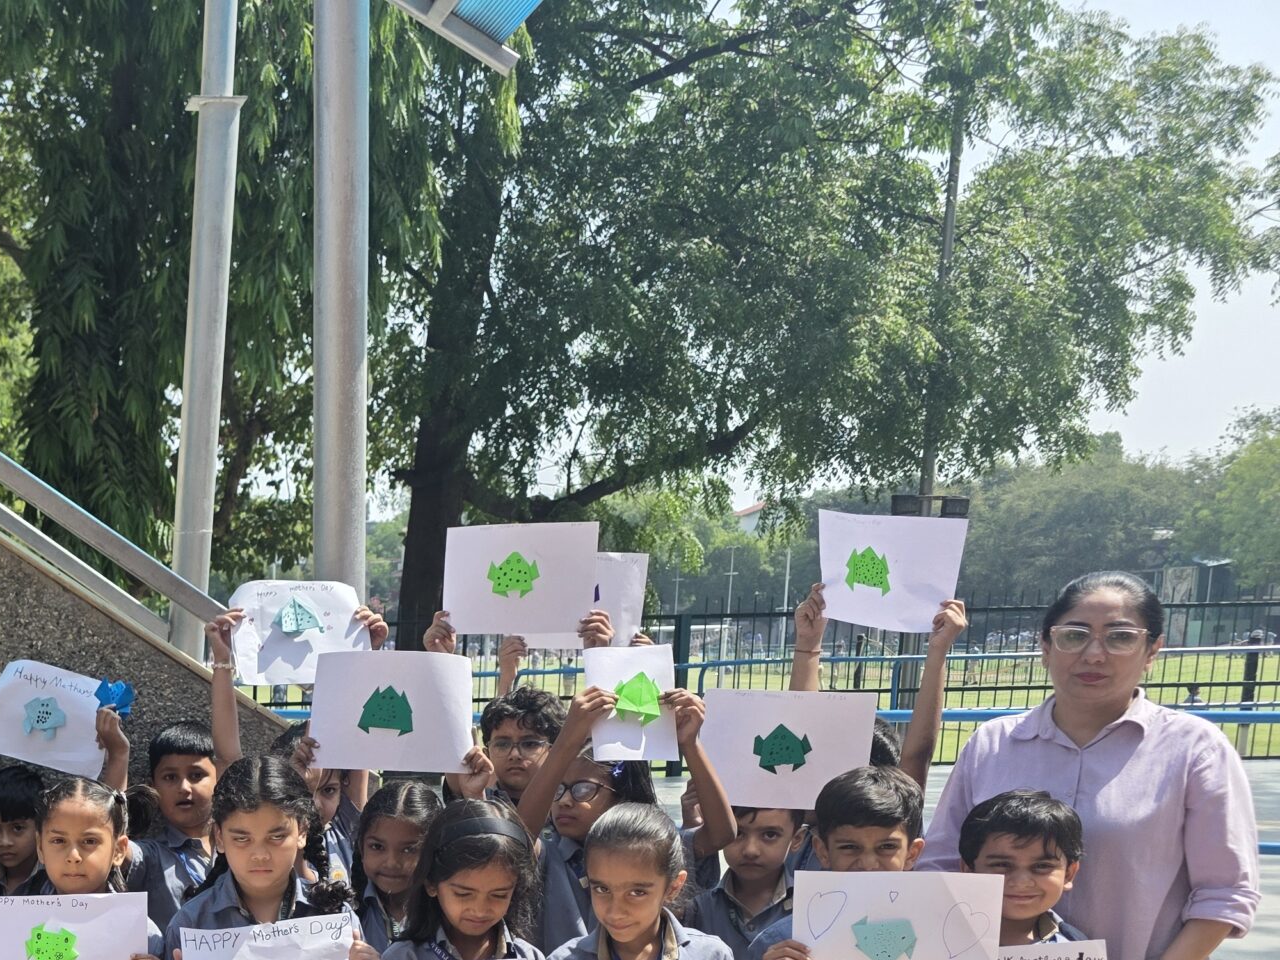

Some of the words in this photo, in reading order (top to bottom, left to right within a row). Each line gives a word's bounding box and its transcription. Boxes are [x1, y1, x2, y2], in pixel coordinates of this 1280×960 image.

[13, 666, 48, 690] Happy
[23, 897, 62, 907] Mother's
[72, 899, 89, 910] Day
[183, 930, 241, 952] HAPPY
[252, 923, 300, 943] Mother's
[309, 915, 350, 941] Day
